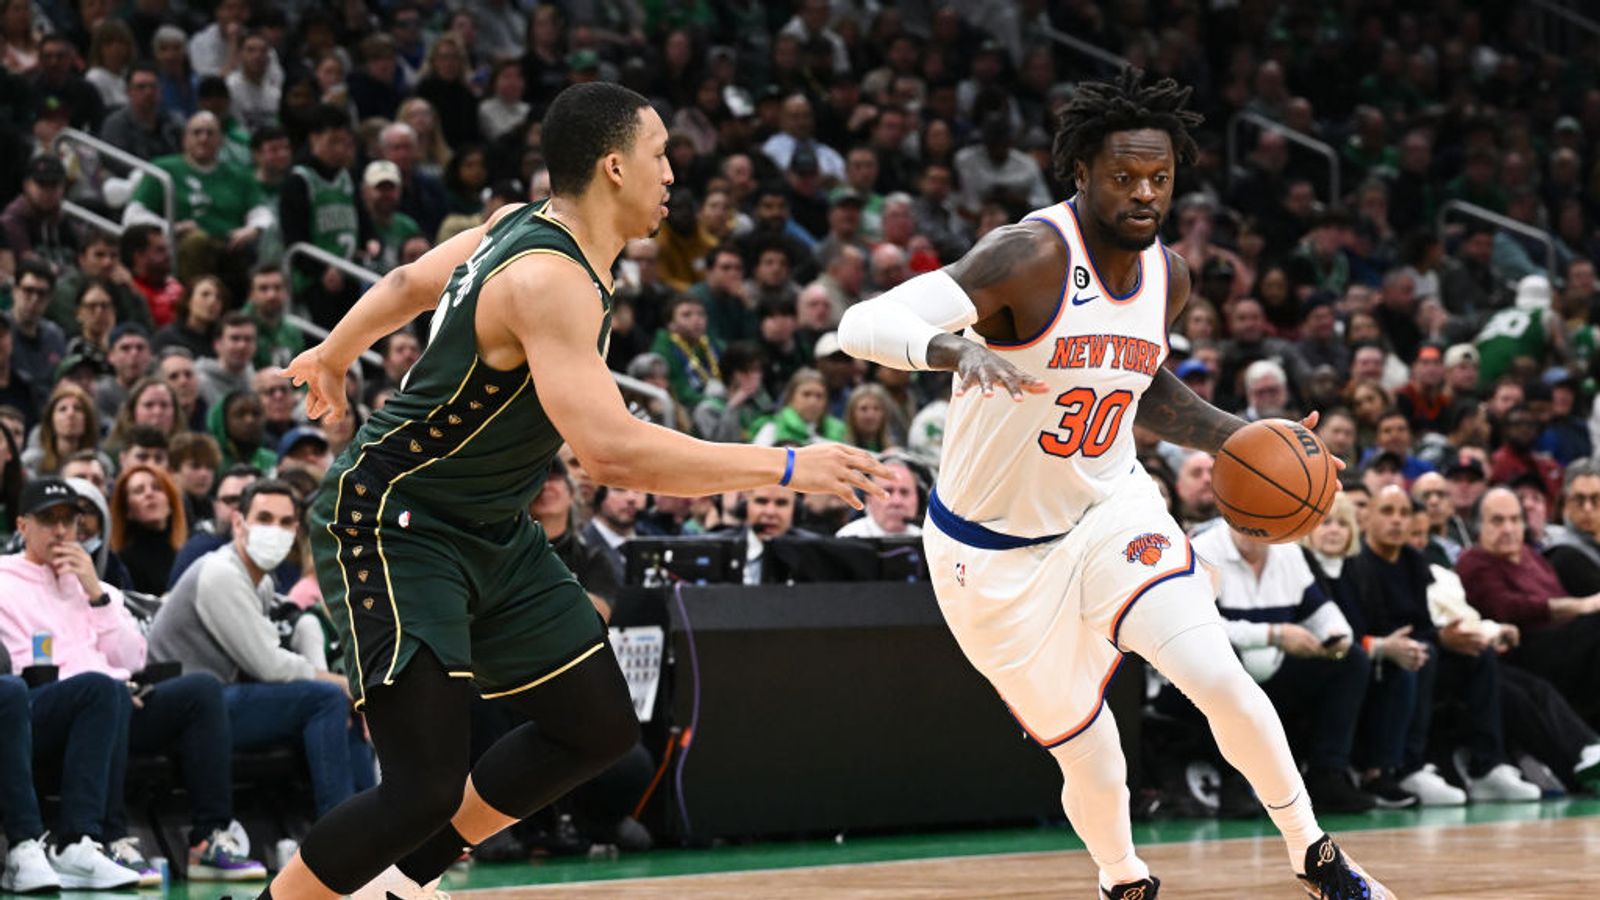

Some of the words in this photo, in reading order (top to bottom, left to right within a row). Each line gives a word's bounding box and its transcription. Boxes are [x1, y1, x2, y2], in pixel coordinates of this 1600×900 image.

[1047, 334, 1112, 369] NEW
[1110, 334, 1161, 378] YORK
[1038, 387, 1134, 458] 30
